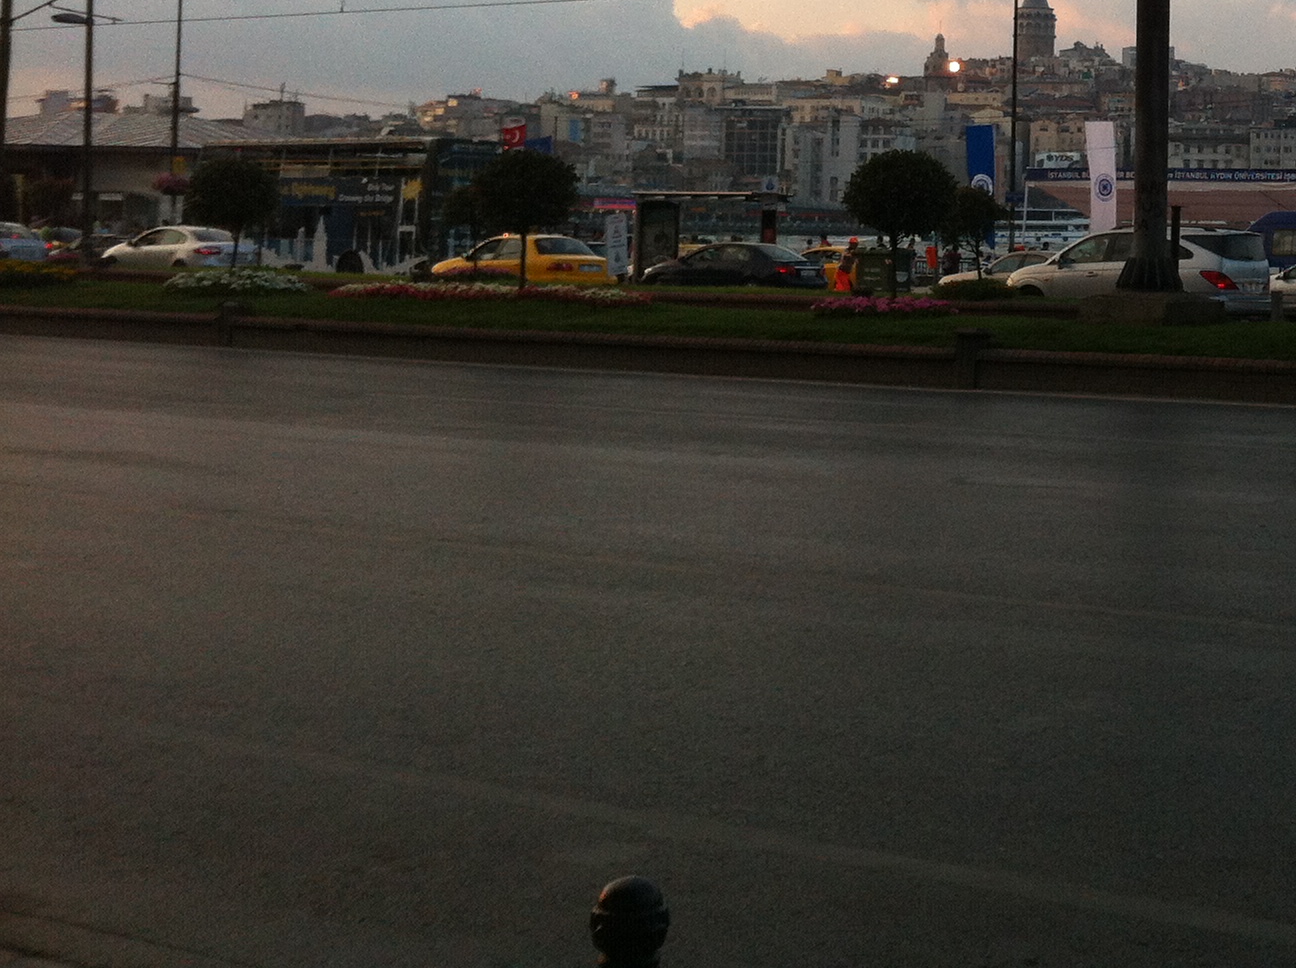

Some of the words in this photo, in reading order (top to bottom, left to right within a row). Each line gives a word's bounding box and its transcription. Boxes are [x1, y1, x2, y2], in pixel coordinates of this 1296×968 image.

[1054, 154, 1075, 162] YDS
[1047, 170, 1081, 179] İSTANBUL
[1174, 170, 1209, 180] İSTANBUL
[1210, 172, 1232, 180] AYDIN
